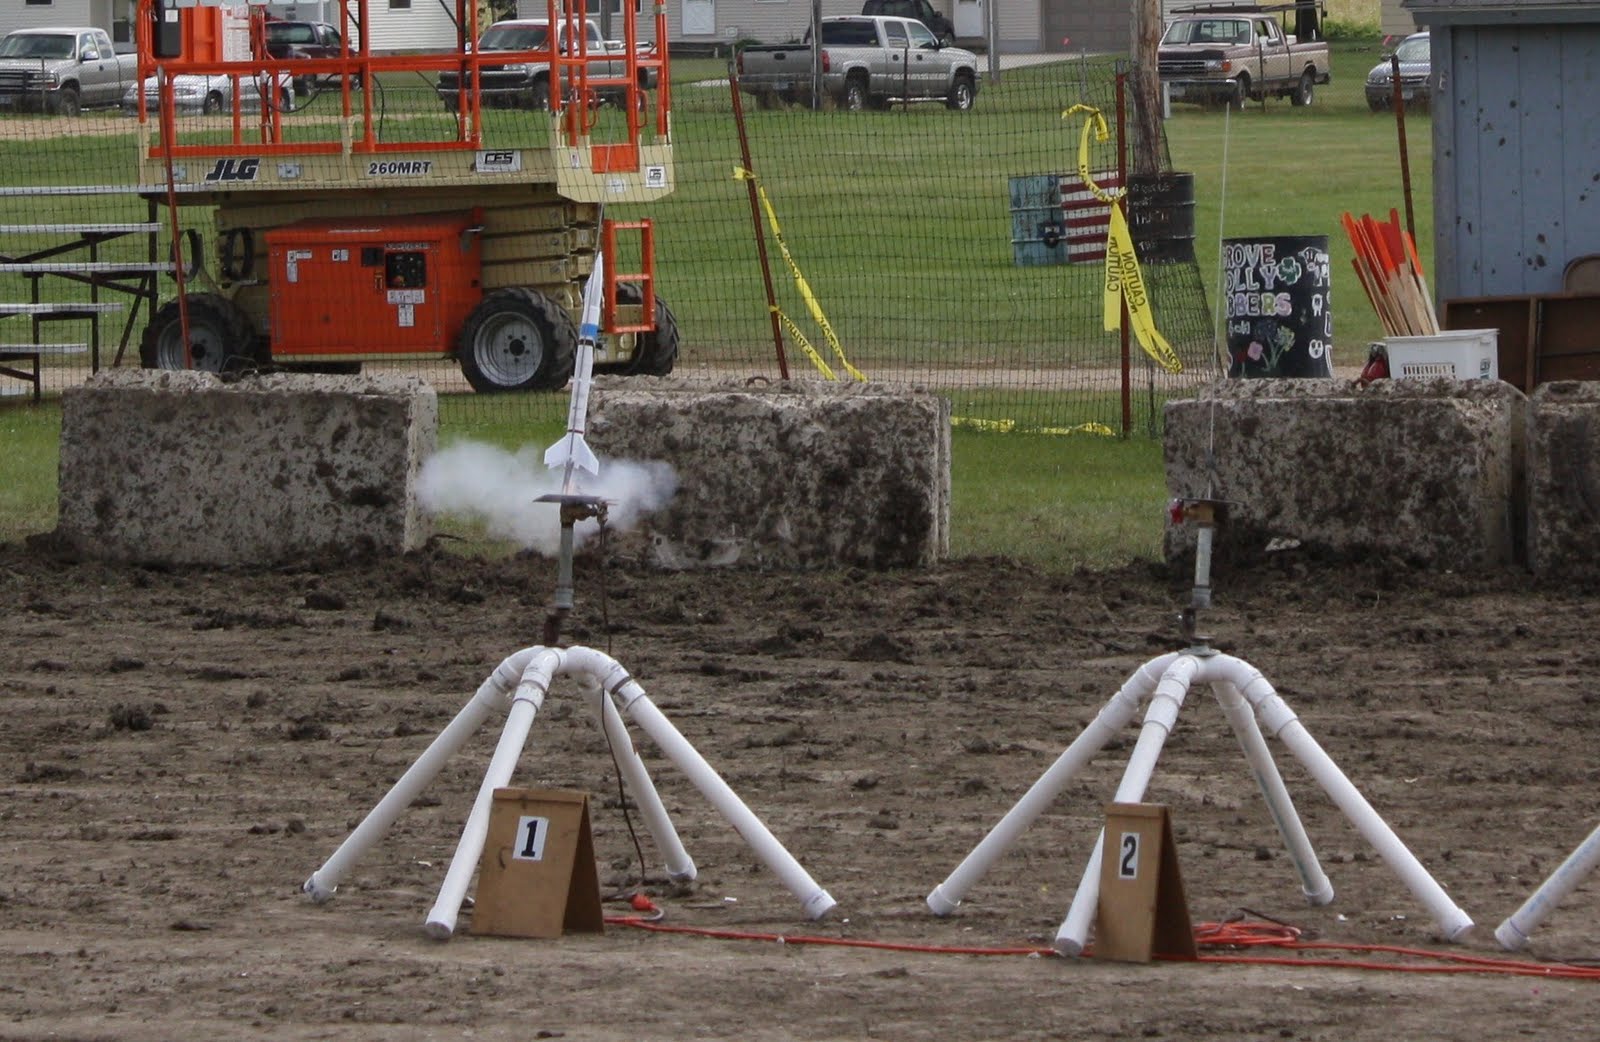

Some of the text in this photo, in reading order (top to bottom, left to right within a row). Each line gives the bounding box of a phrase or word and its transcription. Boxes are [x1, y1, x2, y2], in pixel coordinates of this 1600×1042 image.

[205, 158, 260, 181] JLG
[368, 161, 432, 175] 260MRT
[520, 819, 539, 858] 1
[1121, 835, 1137, 876] 2
